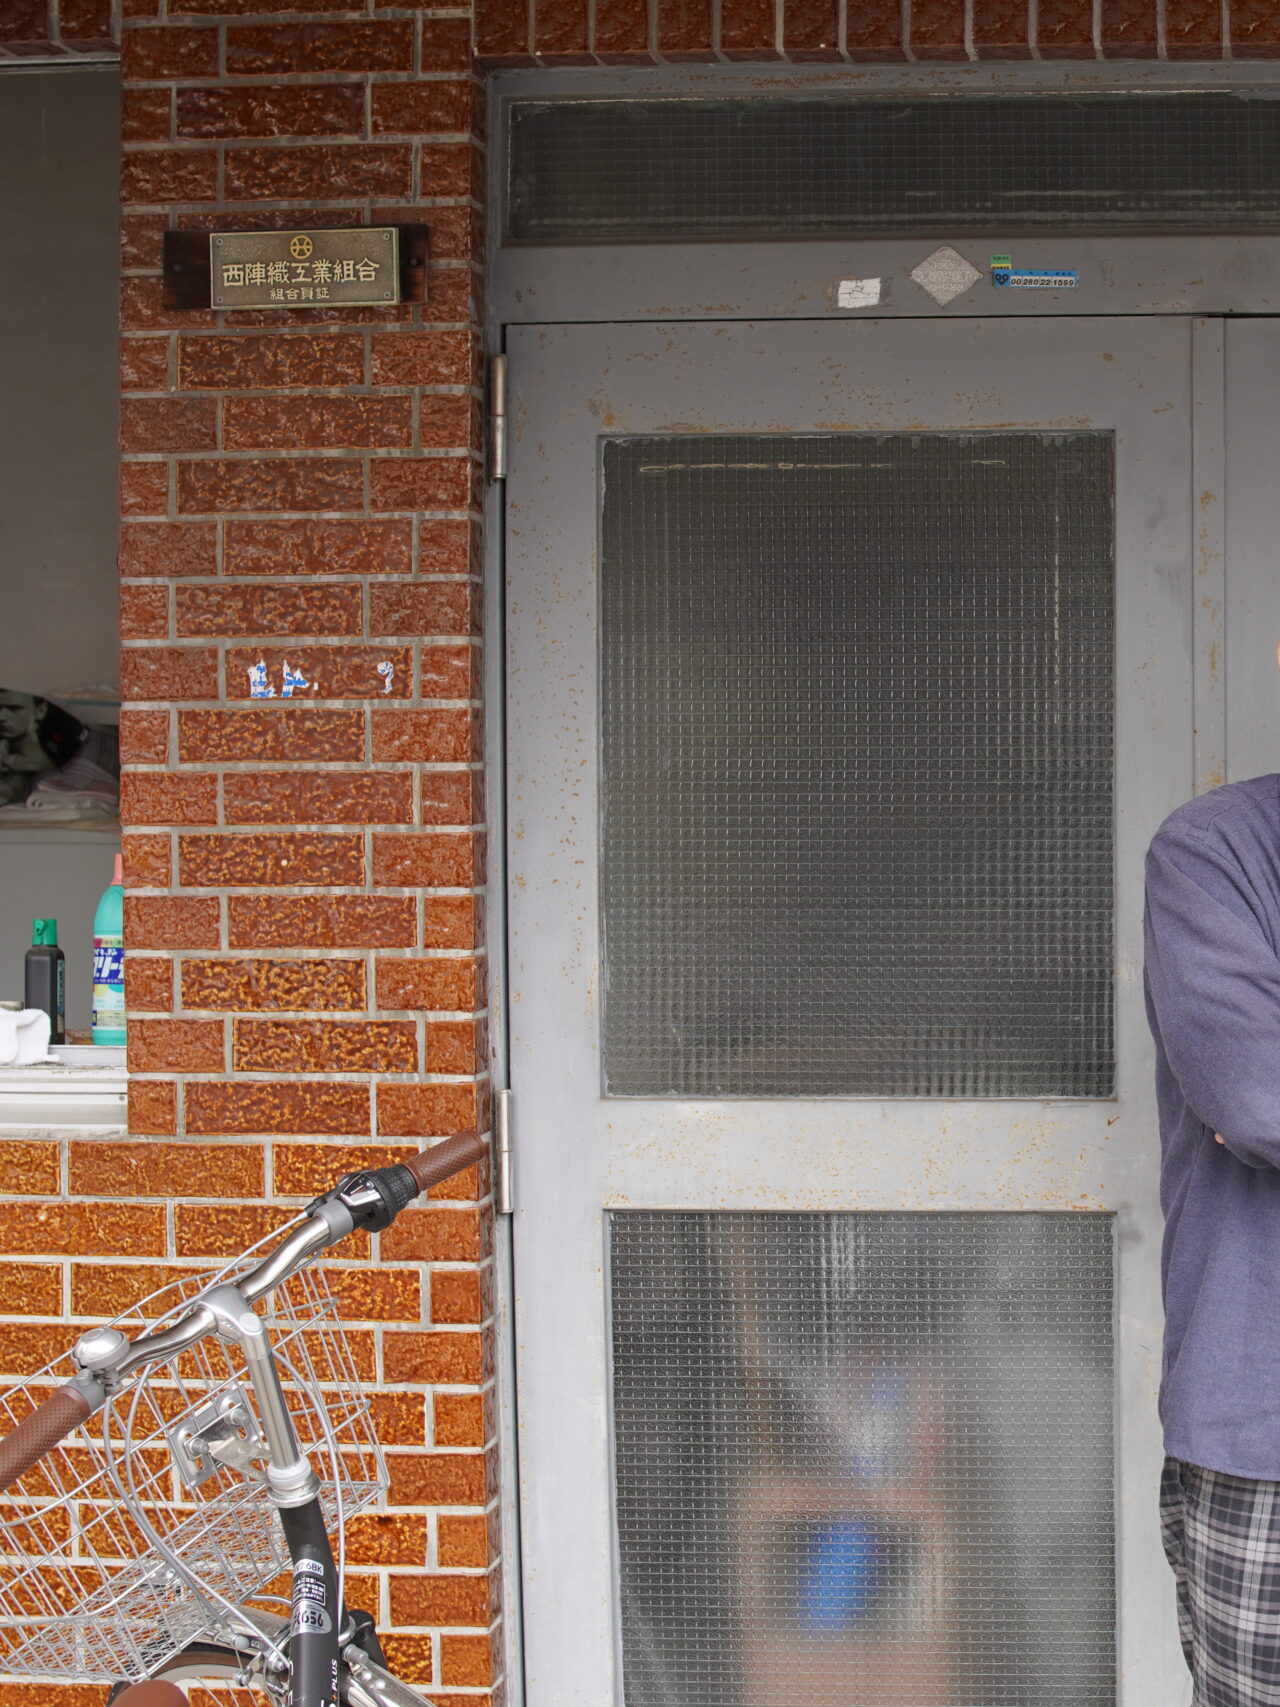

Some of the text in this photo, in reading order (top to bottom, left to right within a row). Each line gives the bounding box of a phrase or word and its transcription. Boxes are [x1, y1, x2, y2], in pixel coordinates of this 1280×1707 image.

[222, 258, 380, 287] 西陣織工業組合
[1010, 278, 1021, 286] 00
[1023, 278, 1039, 286] 280
[1040, 278, 1051, 286] 22
